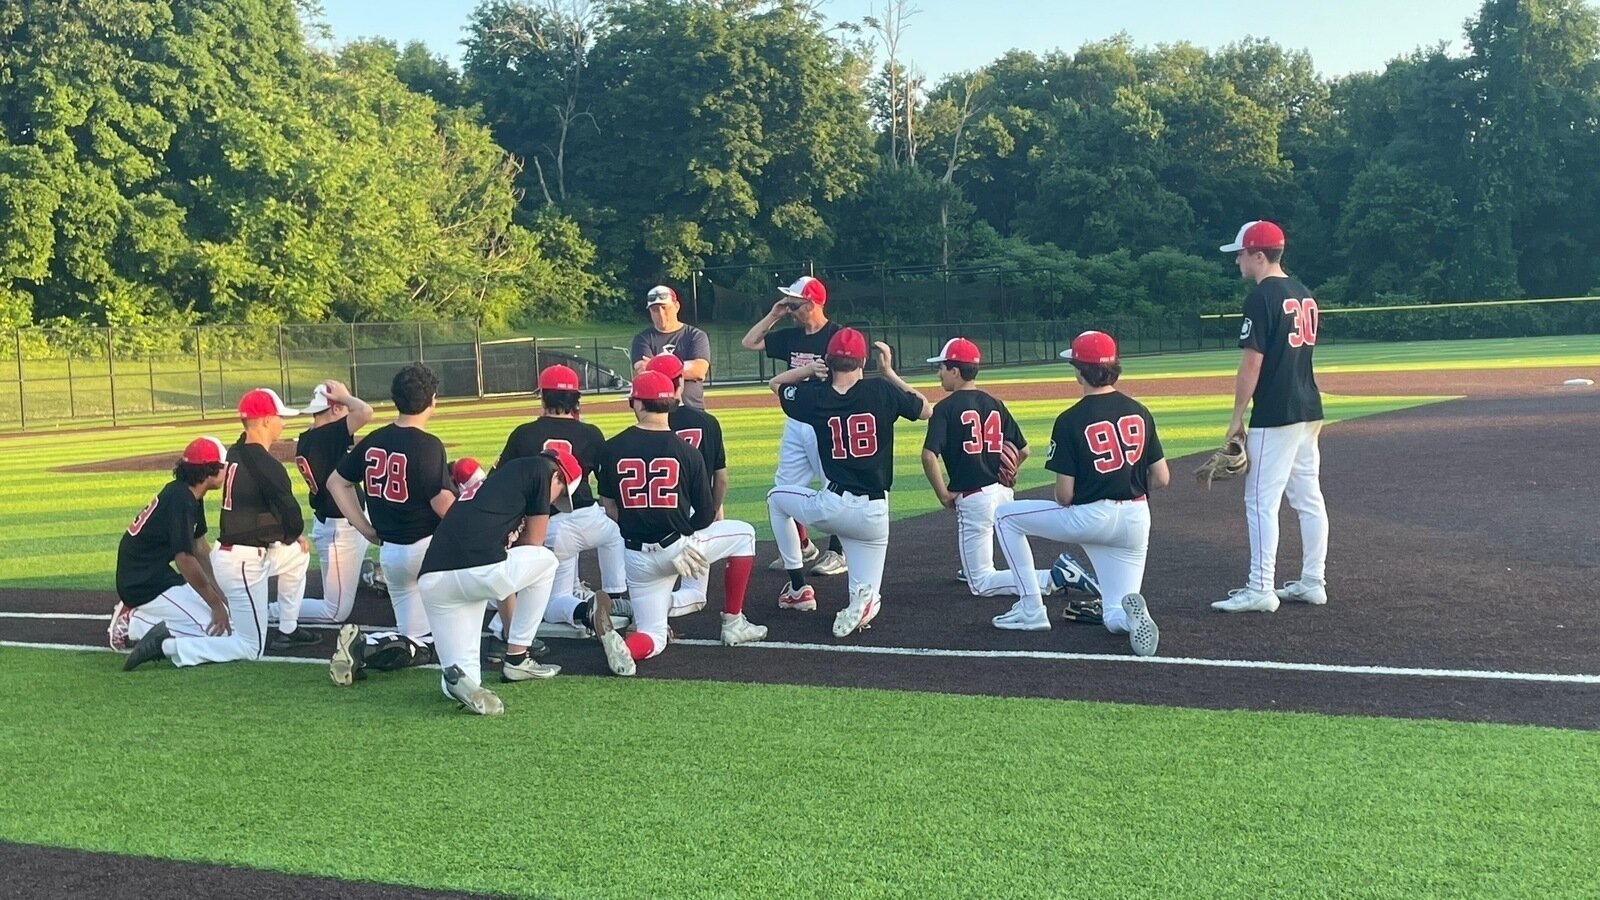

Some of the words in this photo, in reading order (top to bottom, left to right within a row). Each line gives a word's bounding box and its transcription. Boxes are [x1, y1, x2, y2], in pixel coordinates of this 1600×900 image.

[1282, 298, 1319, 348] 30
[827, 412, 877, 460] 18
[961, 409, 1003, 455] 34
[1084, 414, 1145, 474] 99
[364, 447, 409, 503] 28
[617, 457, 680, 509] 22
